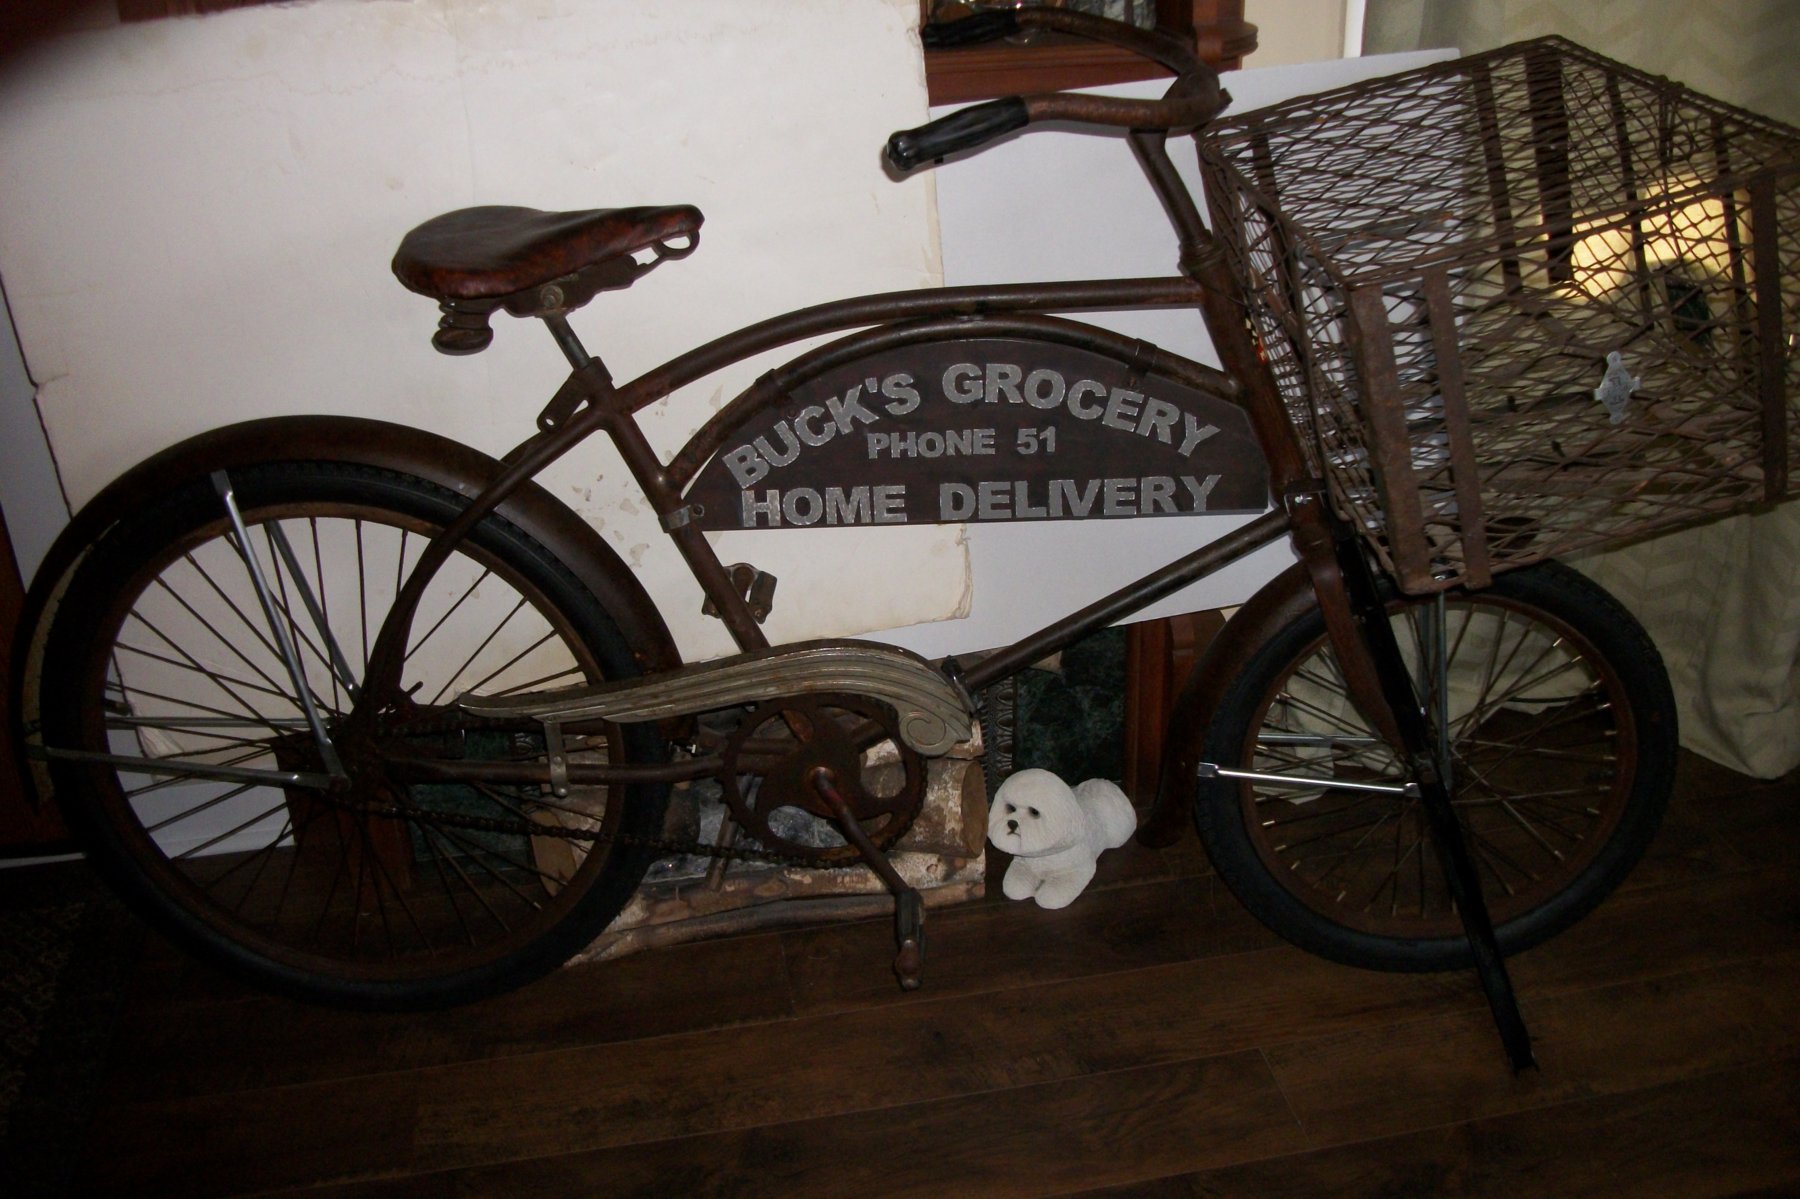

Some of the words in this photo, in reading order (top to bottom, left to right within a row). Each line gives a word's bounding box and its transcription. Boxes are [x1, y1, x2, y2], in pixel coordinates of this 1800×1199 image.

[723, 374, 920, 488] BUCK'S
[942, 363, 1220, 457] GROCERY
[868, 429, 996, 459] PHONE
[1016, 426, 1056, 454] 51
[742, 486, 907, 527] HOME
[940, 474, 1222, 520] DELIVERY
